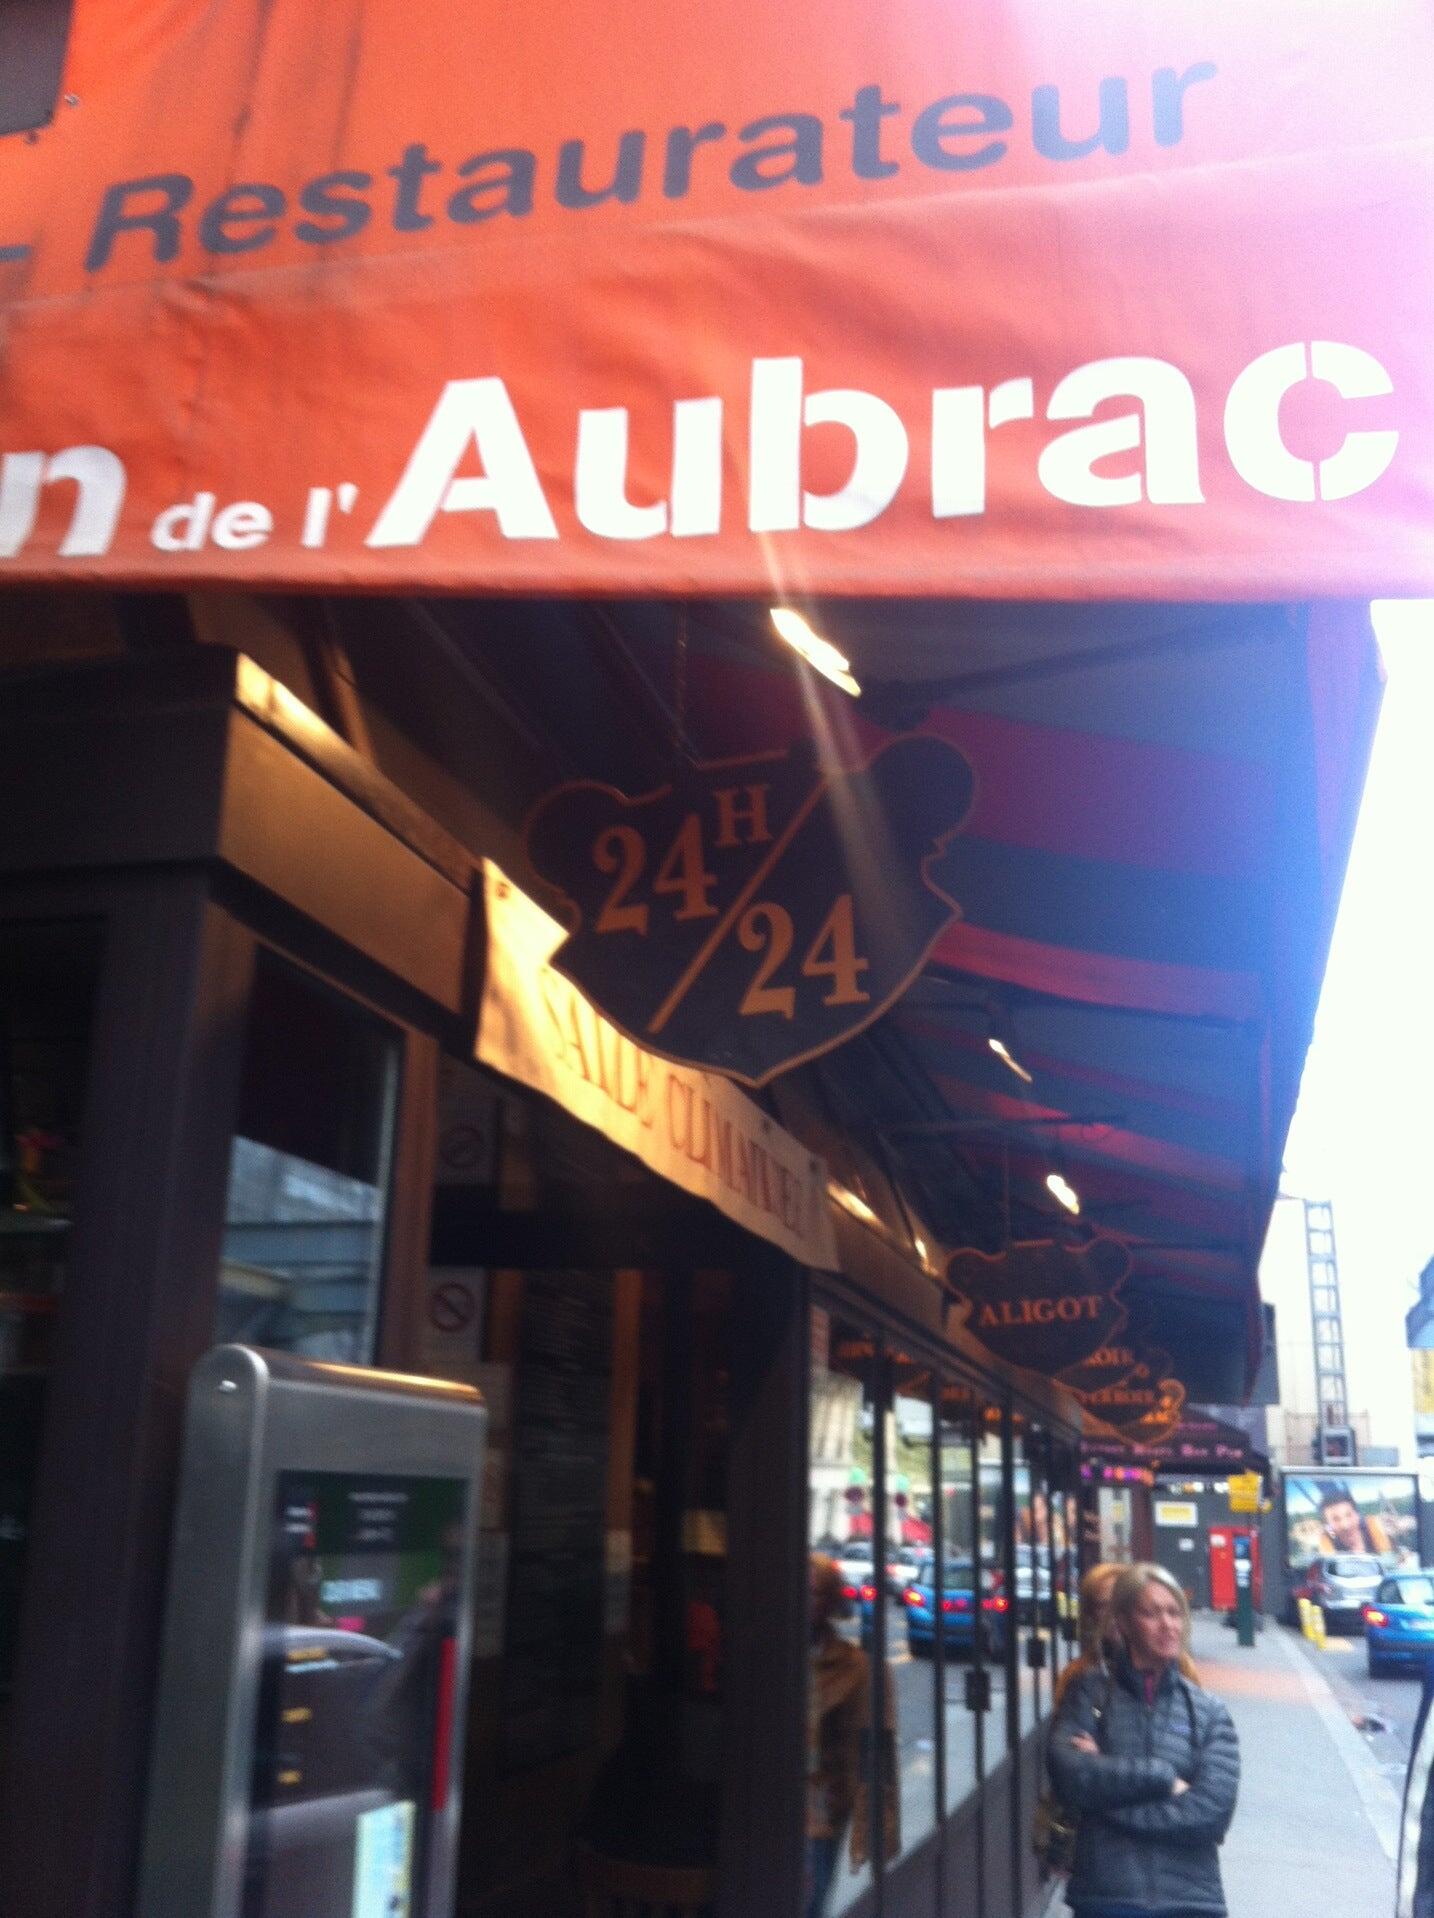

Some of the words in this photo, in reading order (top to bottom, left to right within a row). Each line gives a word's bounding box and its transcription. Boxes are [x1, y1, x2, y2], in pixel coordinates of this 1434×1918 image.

[84, 60, 1218, 272] Restaurateur
[150, 492, 274, 552] de
[978, 1296, 1102, 1328] ALIGOT
